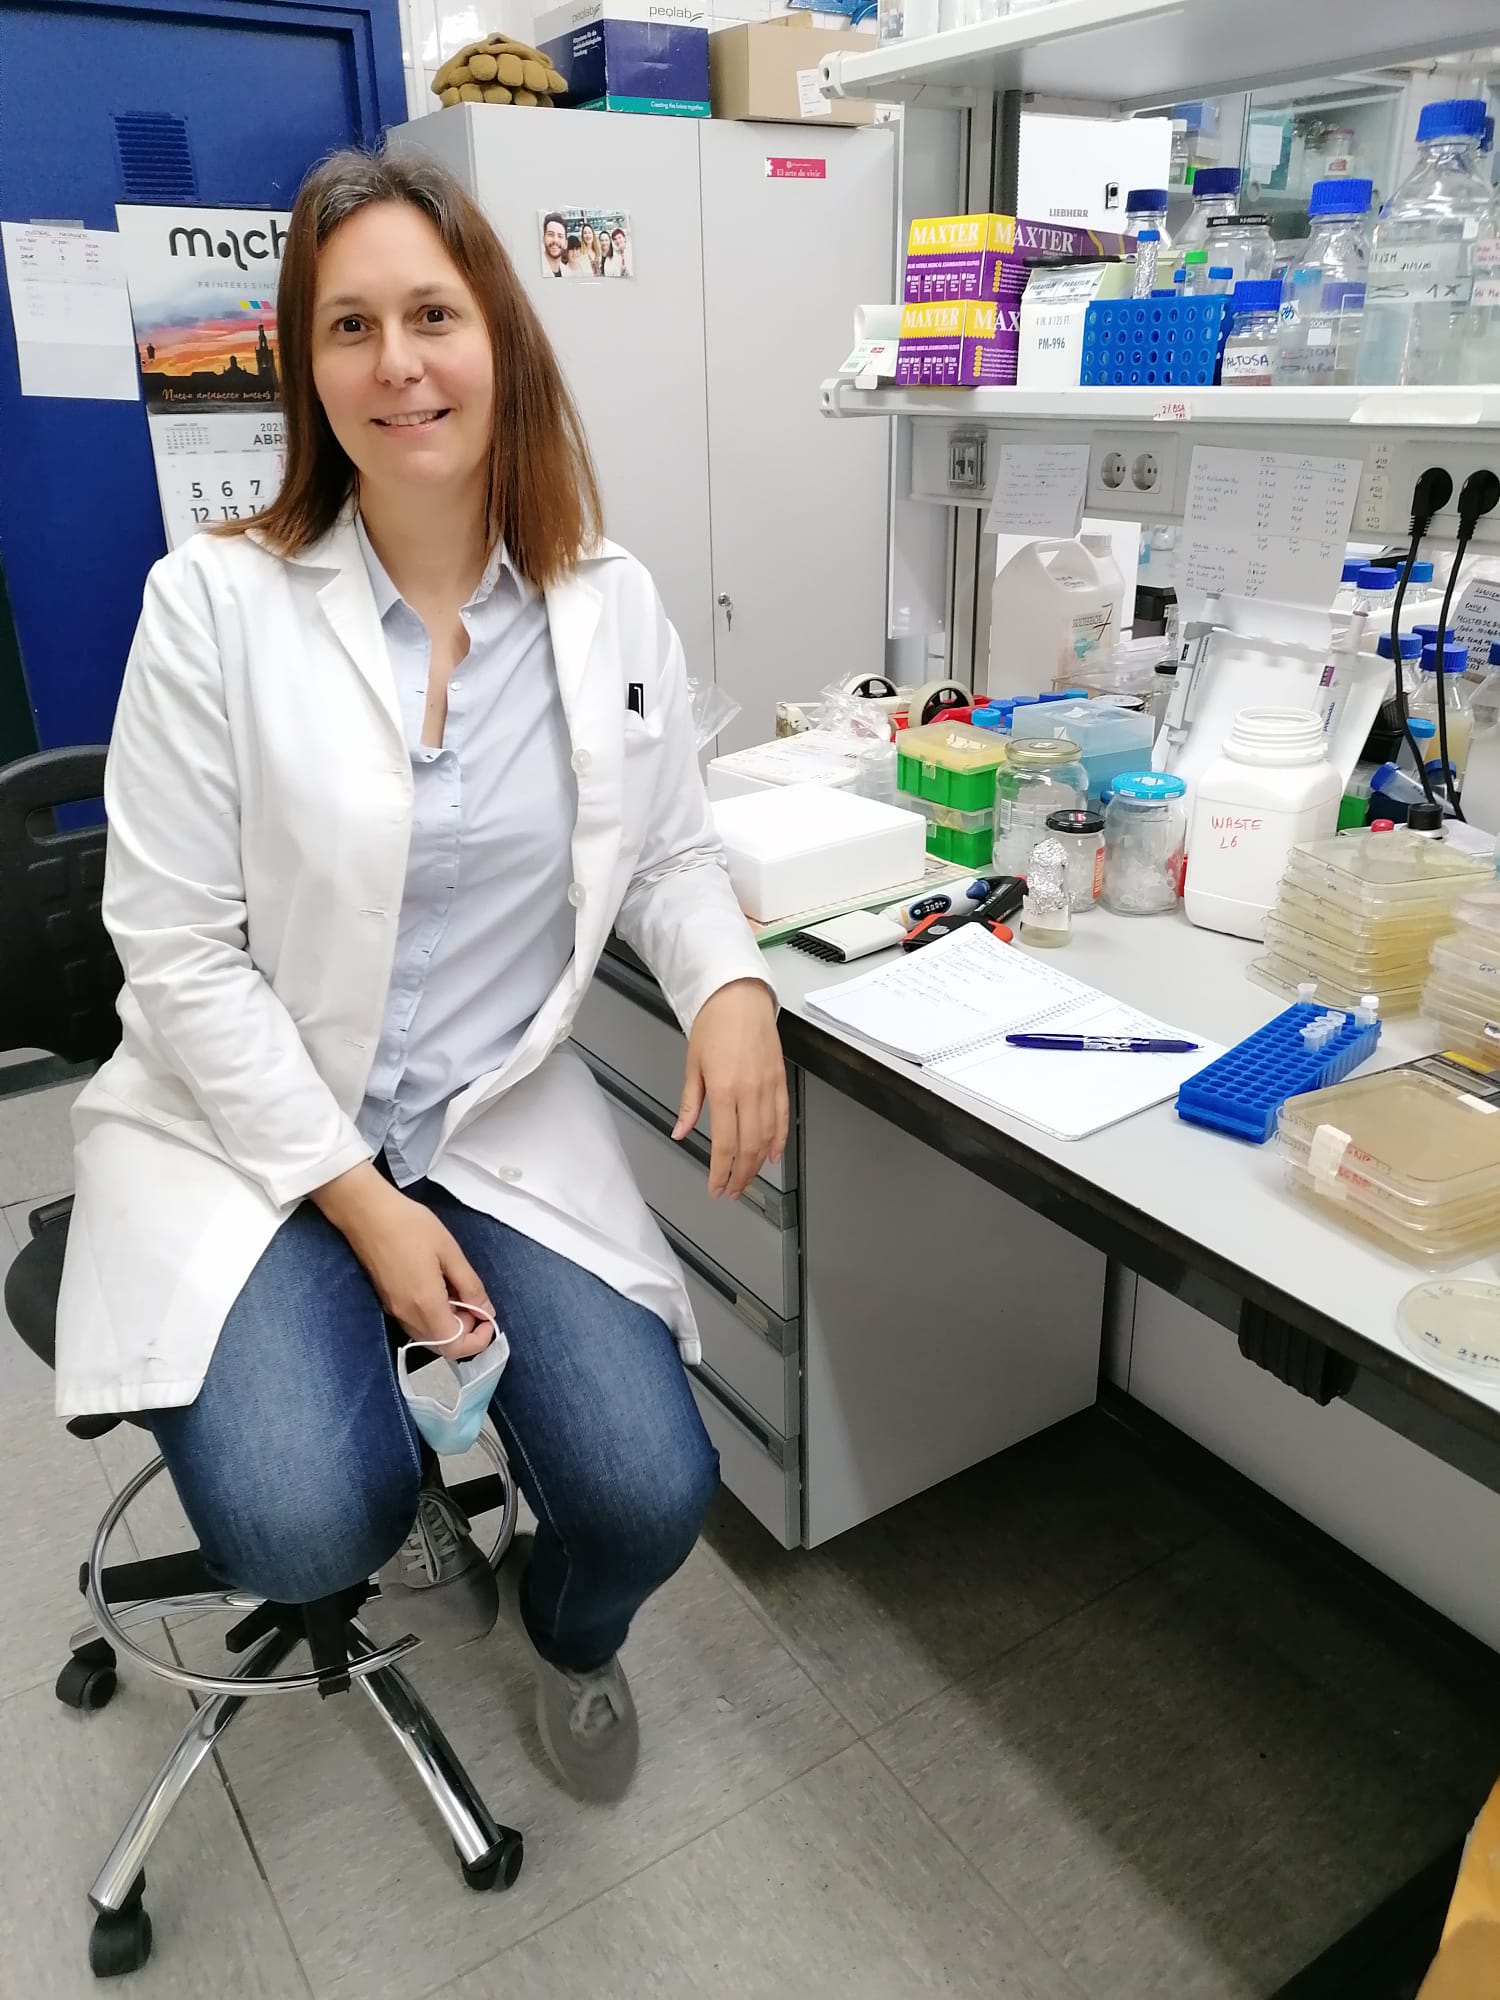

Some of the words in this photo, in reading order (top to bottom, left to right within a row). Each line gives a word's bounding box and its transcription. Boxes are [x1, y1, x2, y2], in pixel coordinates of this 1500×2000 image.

[1049, 208, 1089, 218] LIEBHERR
[912, 222, 979, 245] MAXTER
[994, 221, 1074, 253] MAXTER
[198, 281, 248, 289] PRINTERS
[251, 282, 278, 290] SINC
[904, 307, 960, 329] MAXTER
[973, 308, 1020, 332] MAX
[1038, 337, 1066, 350] PM-996
[1224, 354, 1269, 369] ALTOSA
[253, 433, 286, 445] ABR
[191, 482, 203, 499] 5
[221, 480, 234, 497] 6
[249, 480, 261, 496] 7
[190, 507, 210, 523] 12
[220, 505, 240, 522] 13
[1210, 815, 1264, 831] WASTE
